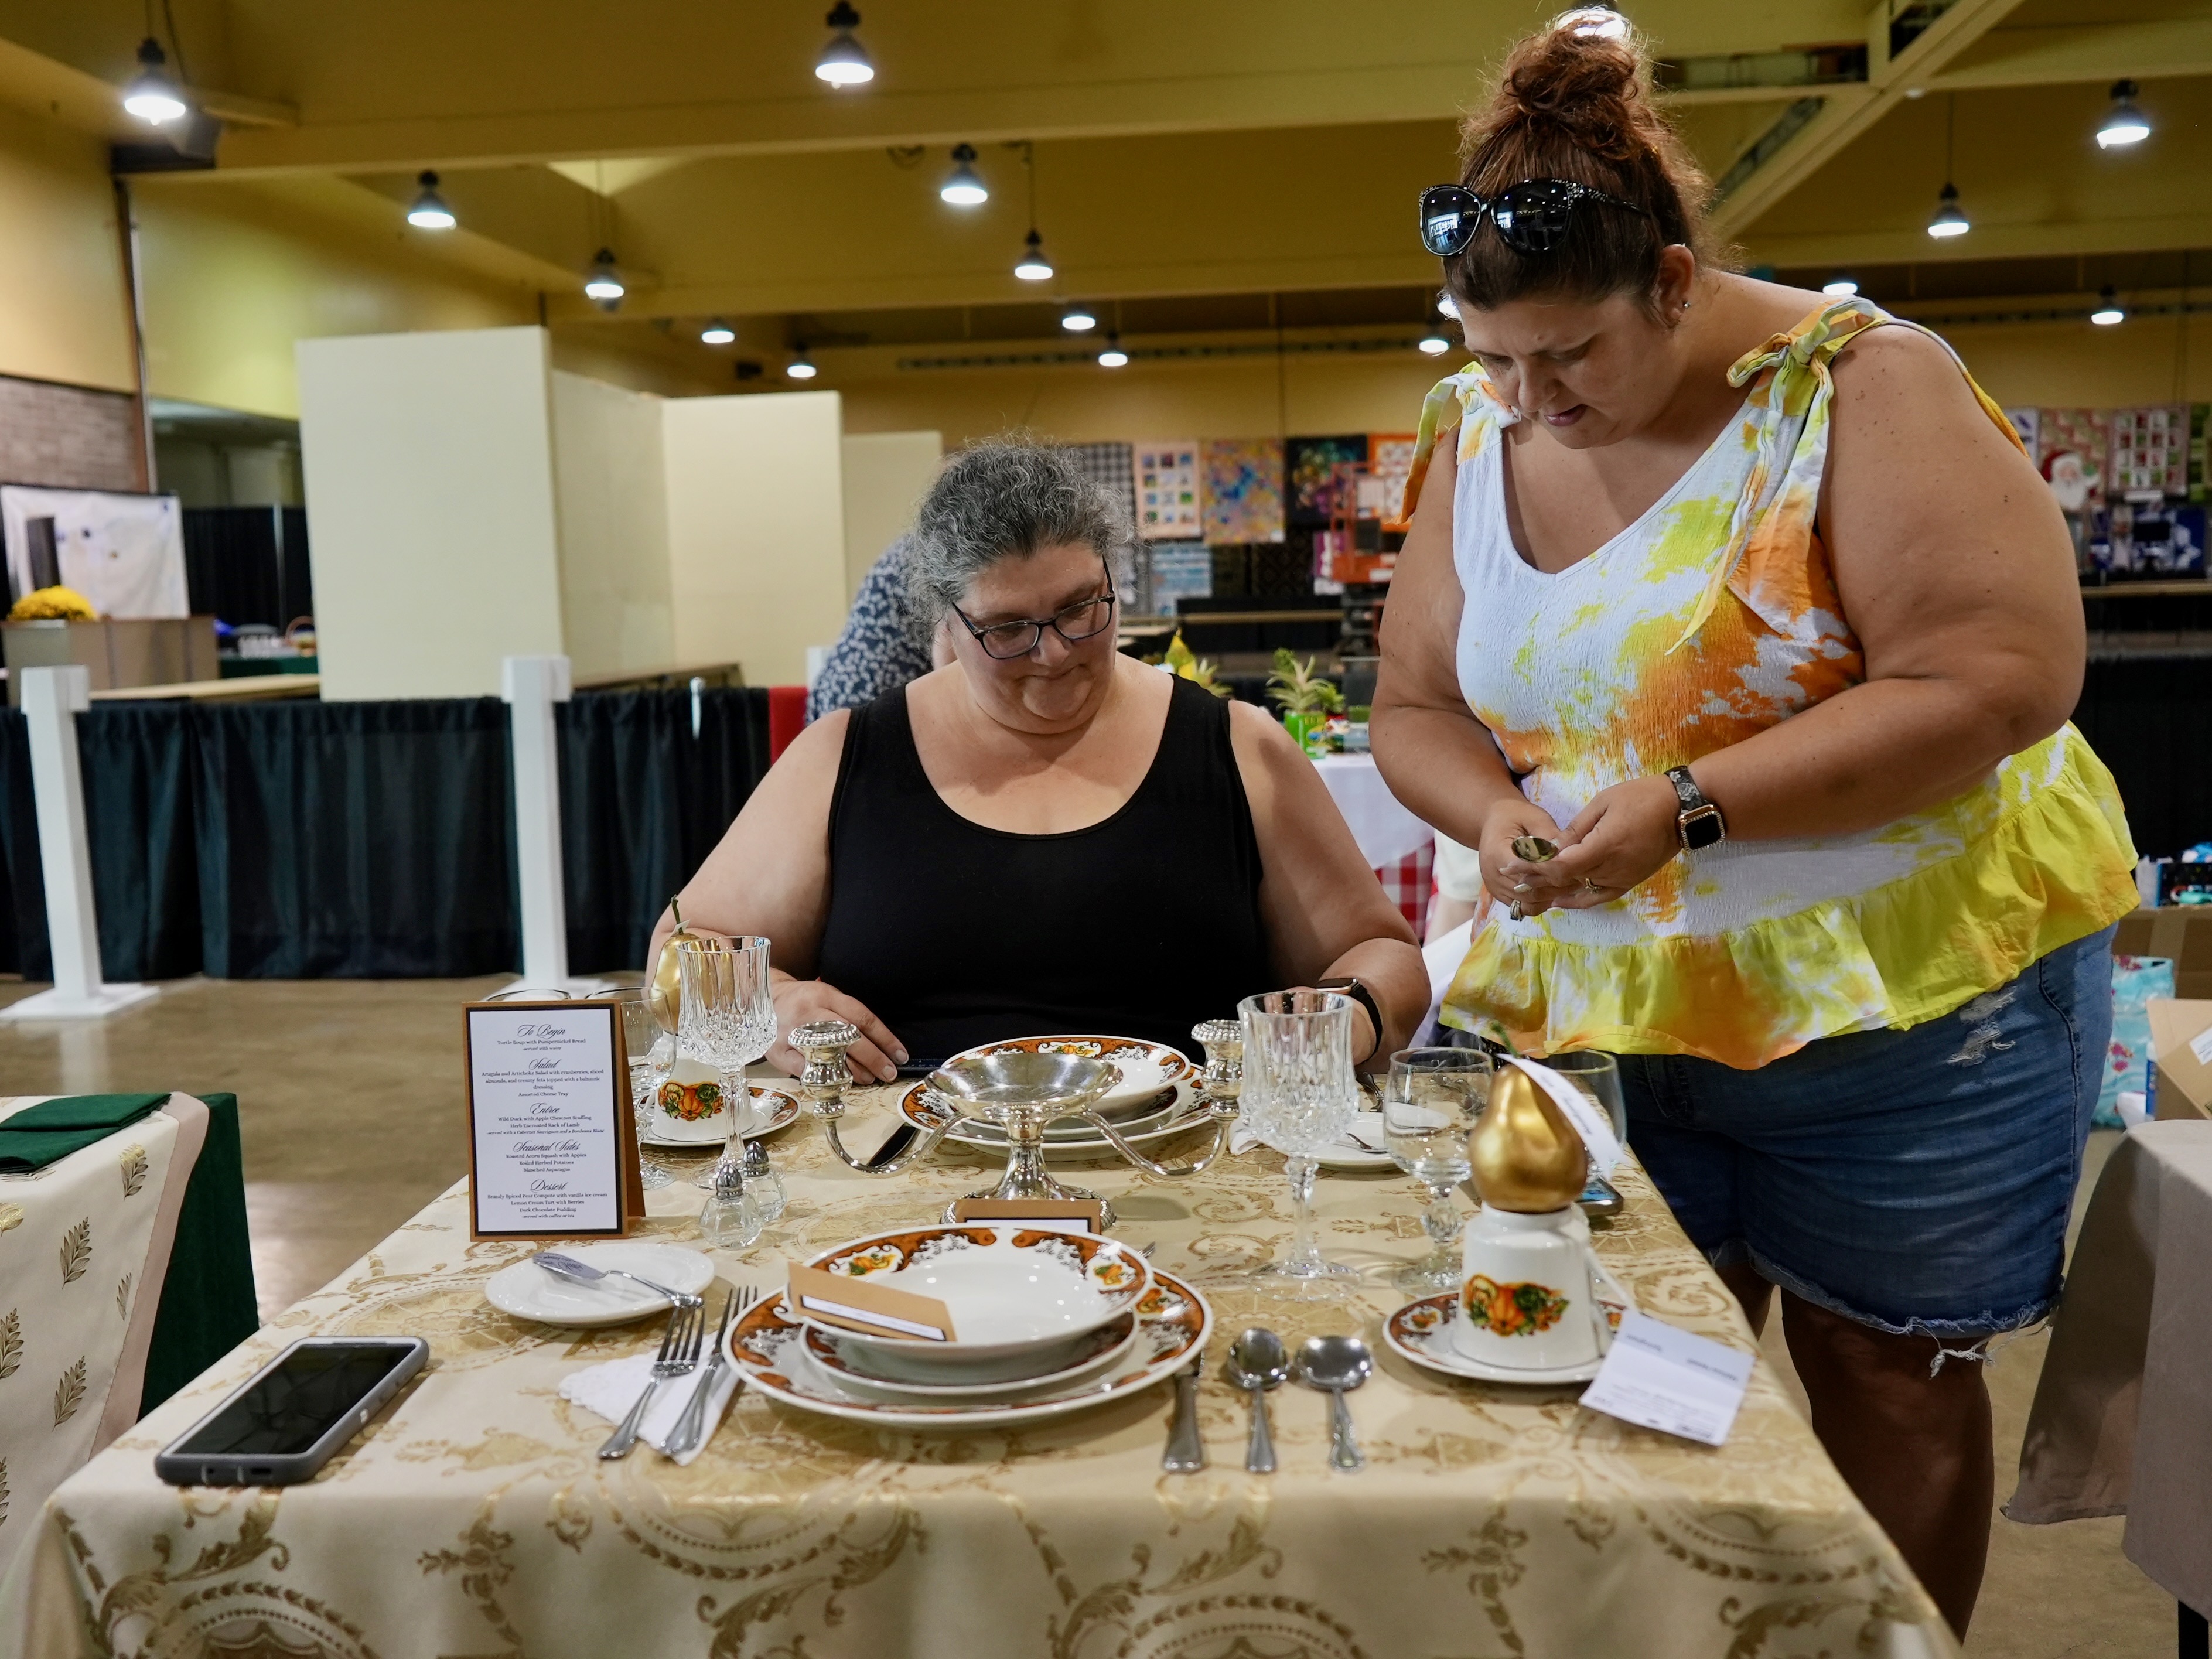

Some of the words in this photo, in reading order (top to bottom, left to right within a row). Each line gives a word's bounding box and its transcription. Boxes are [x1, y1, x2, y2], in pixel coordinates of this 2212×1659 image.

[517, 1024, 538, 1037] To
[536, 1024, 566, 1039] Begin
[529, 1058, 562, 1070] Salad
[513, 1140, 557, 1152] Seasonal
[555, 1139, 581, 1152] Sides
[530, 1179, 568, 1193] Dessert
